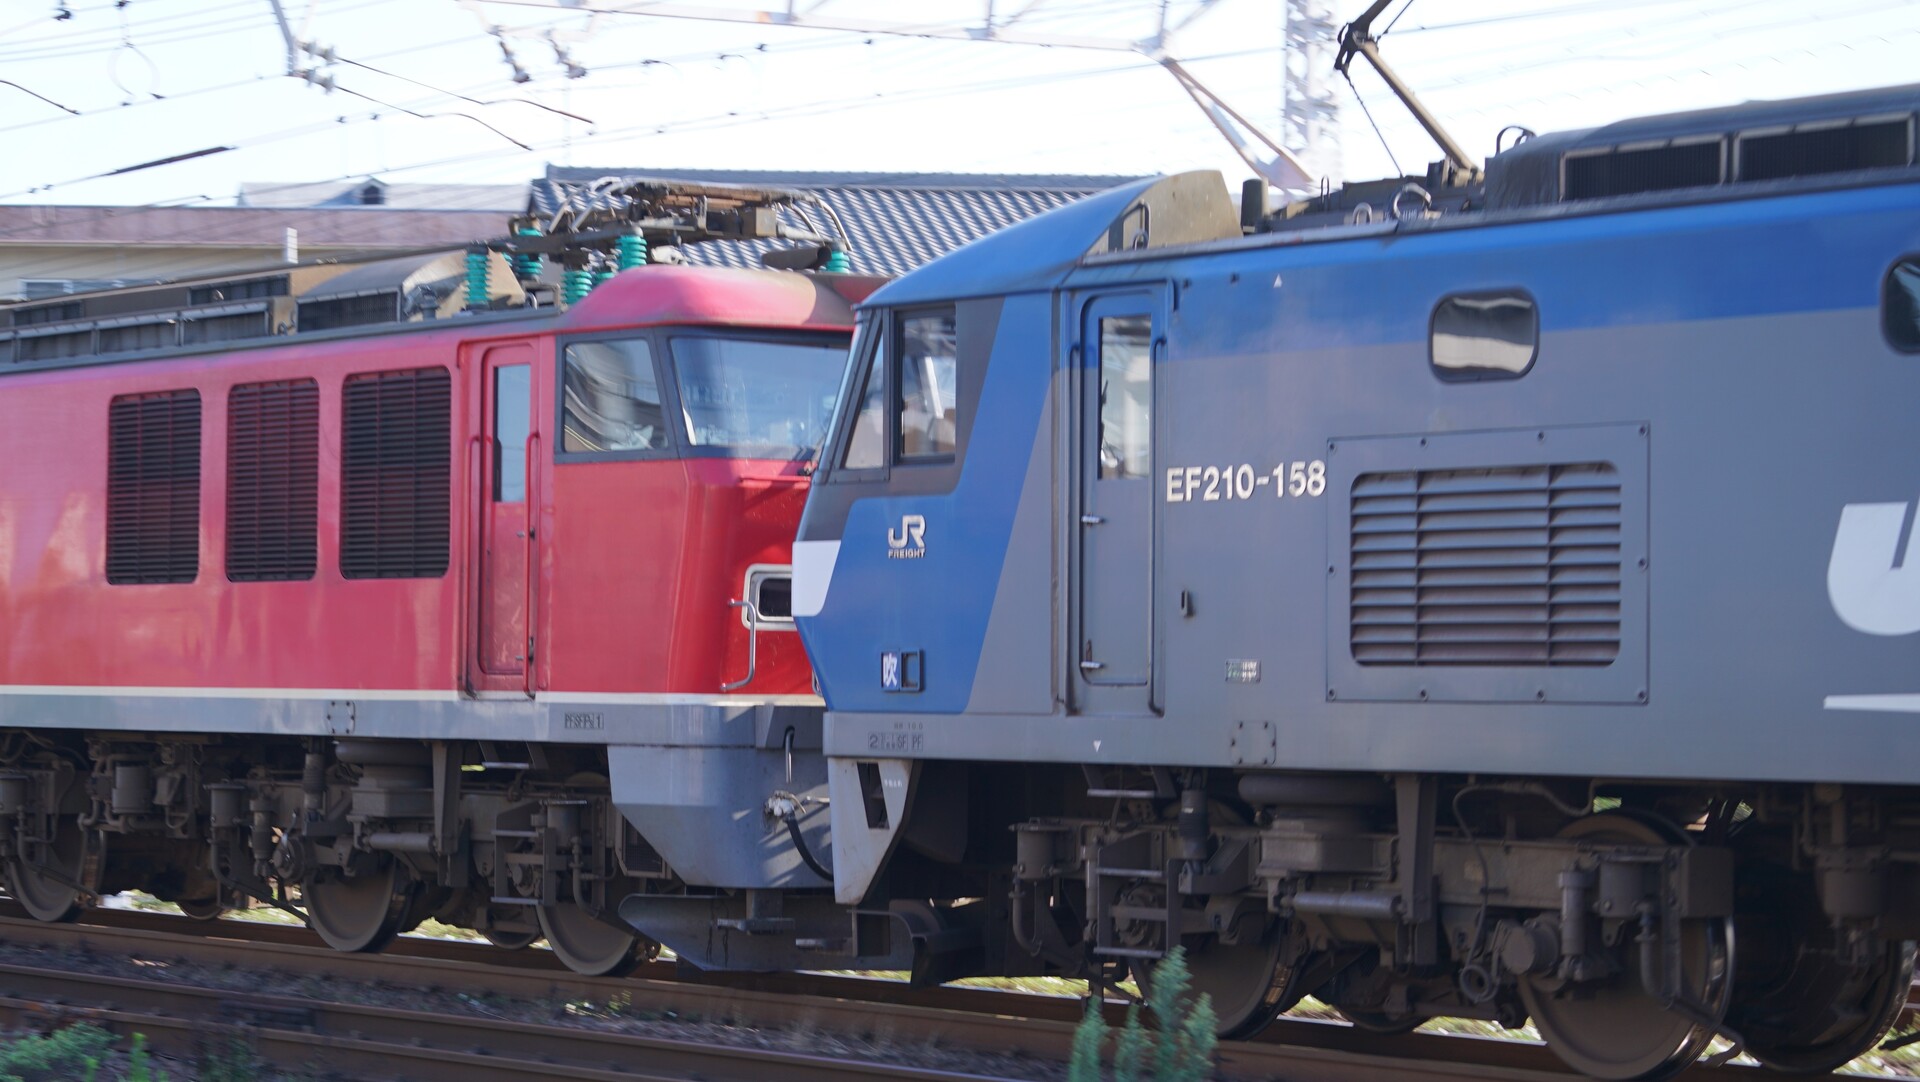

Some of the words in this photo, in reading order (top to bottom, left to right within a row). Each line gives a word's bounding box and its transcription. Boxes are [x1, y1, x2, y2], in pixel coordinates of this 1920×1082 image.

[1166, 460, 1327, 502] EF210-158
[887, 514, 926, 549] JR
[887, 548, 926, 559] FREIGHT
[882, 652, 898, 687] 吹
